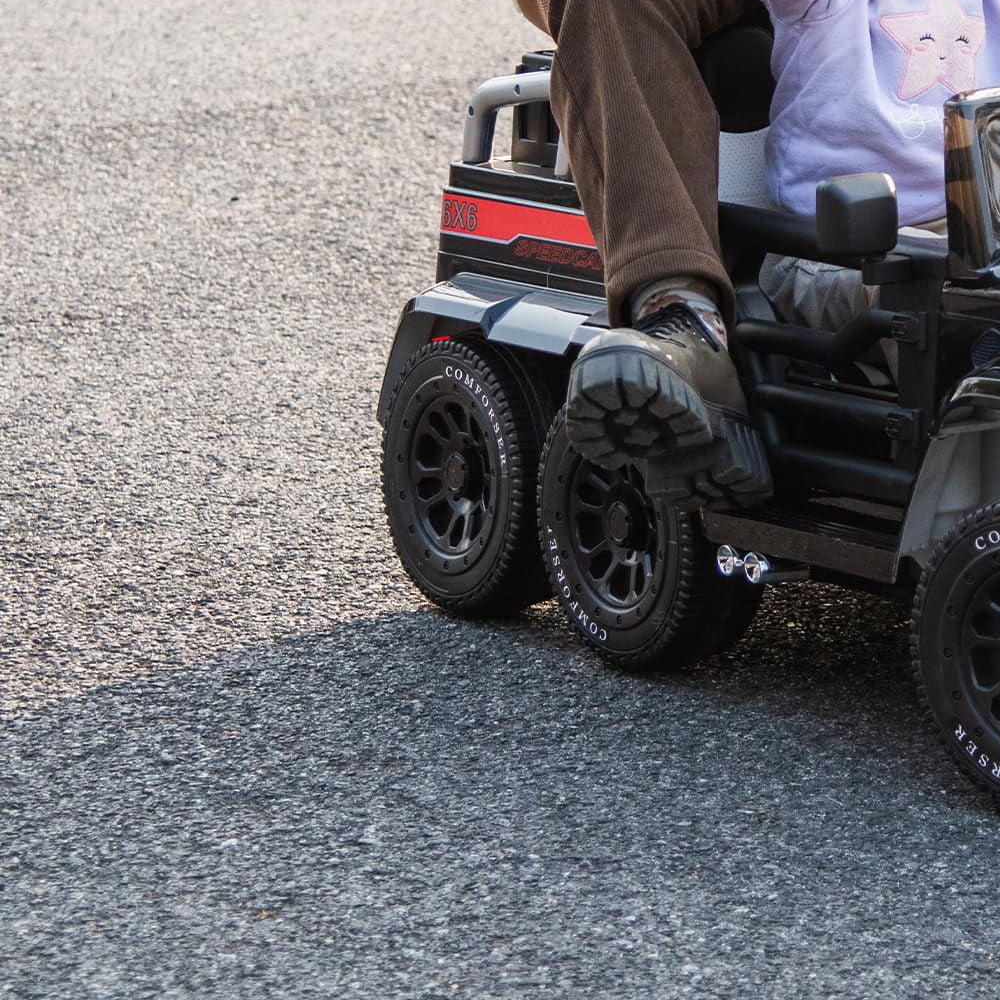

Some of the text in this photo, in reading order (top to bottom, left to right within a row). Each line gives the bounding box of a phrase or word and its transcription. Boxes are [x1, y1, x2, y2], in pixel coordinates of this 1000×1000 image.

[442, 199, 478, 231] 6X6
[514, 239, 605, 271] SPEEDCA
[445, 365, 507, 466] COMFORSER
